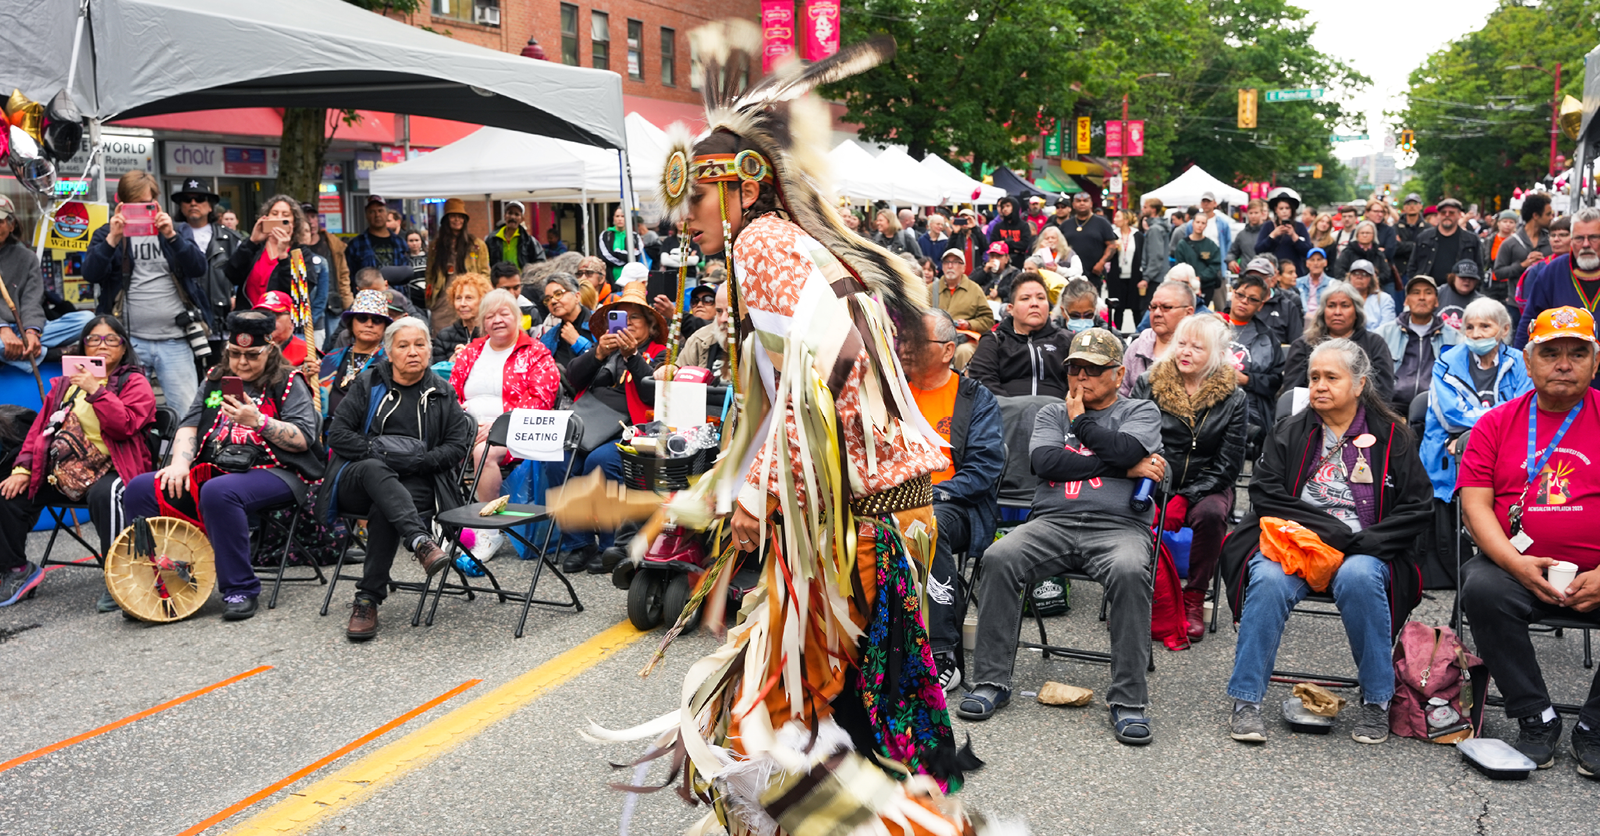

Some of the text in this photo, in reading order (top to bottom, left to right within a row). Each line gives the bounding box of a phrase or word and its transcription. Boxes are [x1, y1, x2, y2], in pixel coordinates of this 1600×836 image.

[1278, 90, 1308, 100] Pender
[1310, 89, 1321, 99] St
[173, 145, 215, 165] chatr
[106, 156, 138, 165] Repairs
[523, 416, 555, 425] ELDER
[515, 432, 558, 441] SEATING
